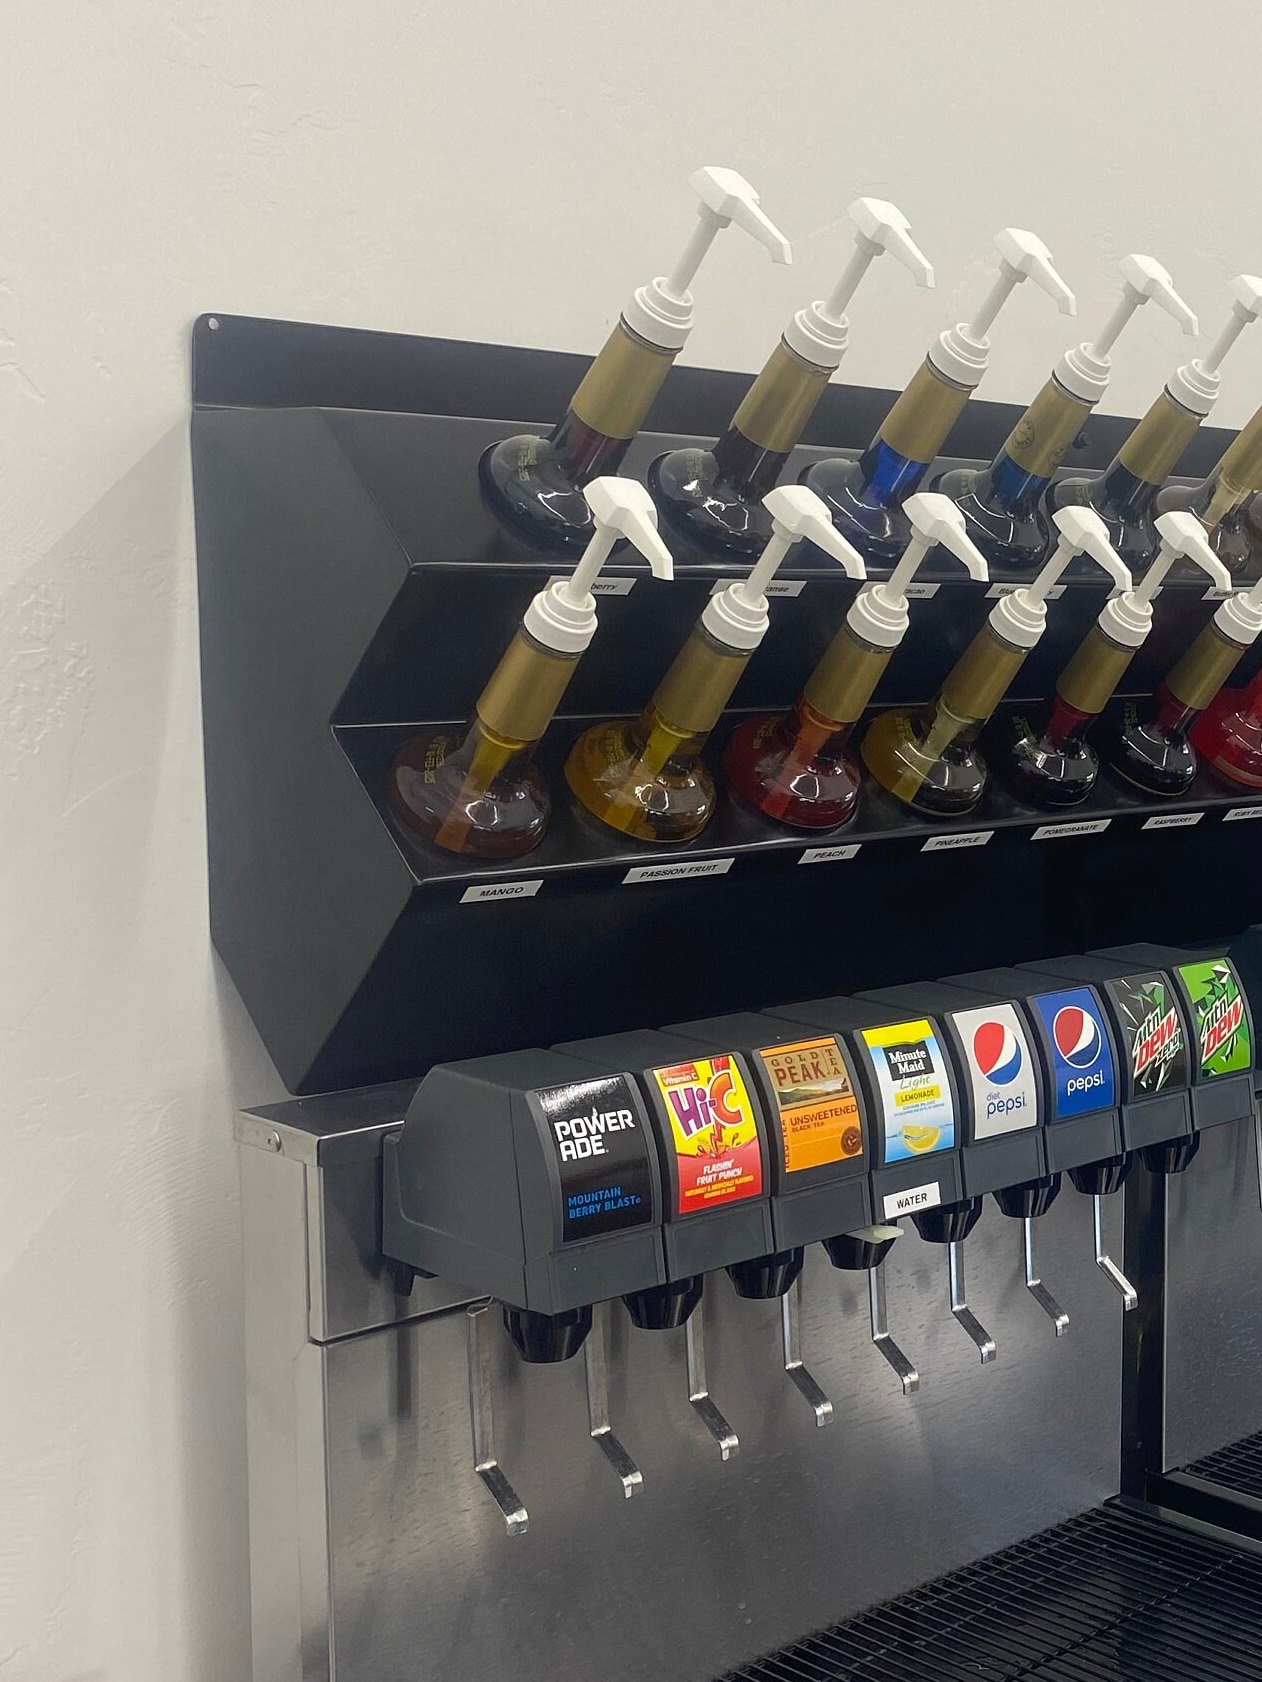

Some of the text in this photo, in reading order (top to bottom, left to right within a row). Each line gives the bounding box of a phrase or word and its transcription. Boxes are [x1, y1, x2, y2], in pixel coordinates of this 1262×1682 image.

[1043, 823, 1099, 836] POMEGRANATE
[1152, 816, 1192, 826] RASPBERRY
[934, 836, 979, 847] PINEAPPLE
[813, 849, 845, 859] PEACH
[640, 863, 718, 879] PASSION FRUIT
[479, 886, 523, 898] MANGO
[771, 1051, 819, 1068] GOLD
[825, 1047, 842, 1076] TEA
[888, 1048, 927, 1064] Minute
[774, 1060, 826, 1086] PEAK
[897, 1059, 926, 1074] Maid
[900, 1072, 931, 1091] Light
[1067, 1070, 1104, 1096] pepsi
[901, 1089, 936, 1102] LEMONADE
[986, 1091, 1001, 1101] diet
[667, 1071, 744, 1138] Hi-C
[987, 1091, 1027, 1120] pepsi
[790, 1103, 858, 1127] UNSWEETENED
[554, 1107, 635, 1142] POWER
[791, 1120, 825, 1133] BLACK TEA
[560, 1134, 606, 1162] ADE
[697, 1167, 743, 1187] FRUIT PUNCH
[568, 1186, 622, 1207] MOUNTAIN
[896, 1192, 928, 1209] WATER
[569, 1203, 602, 1219] BERRY
